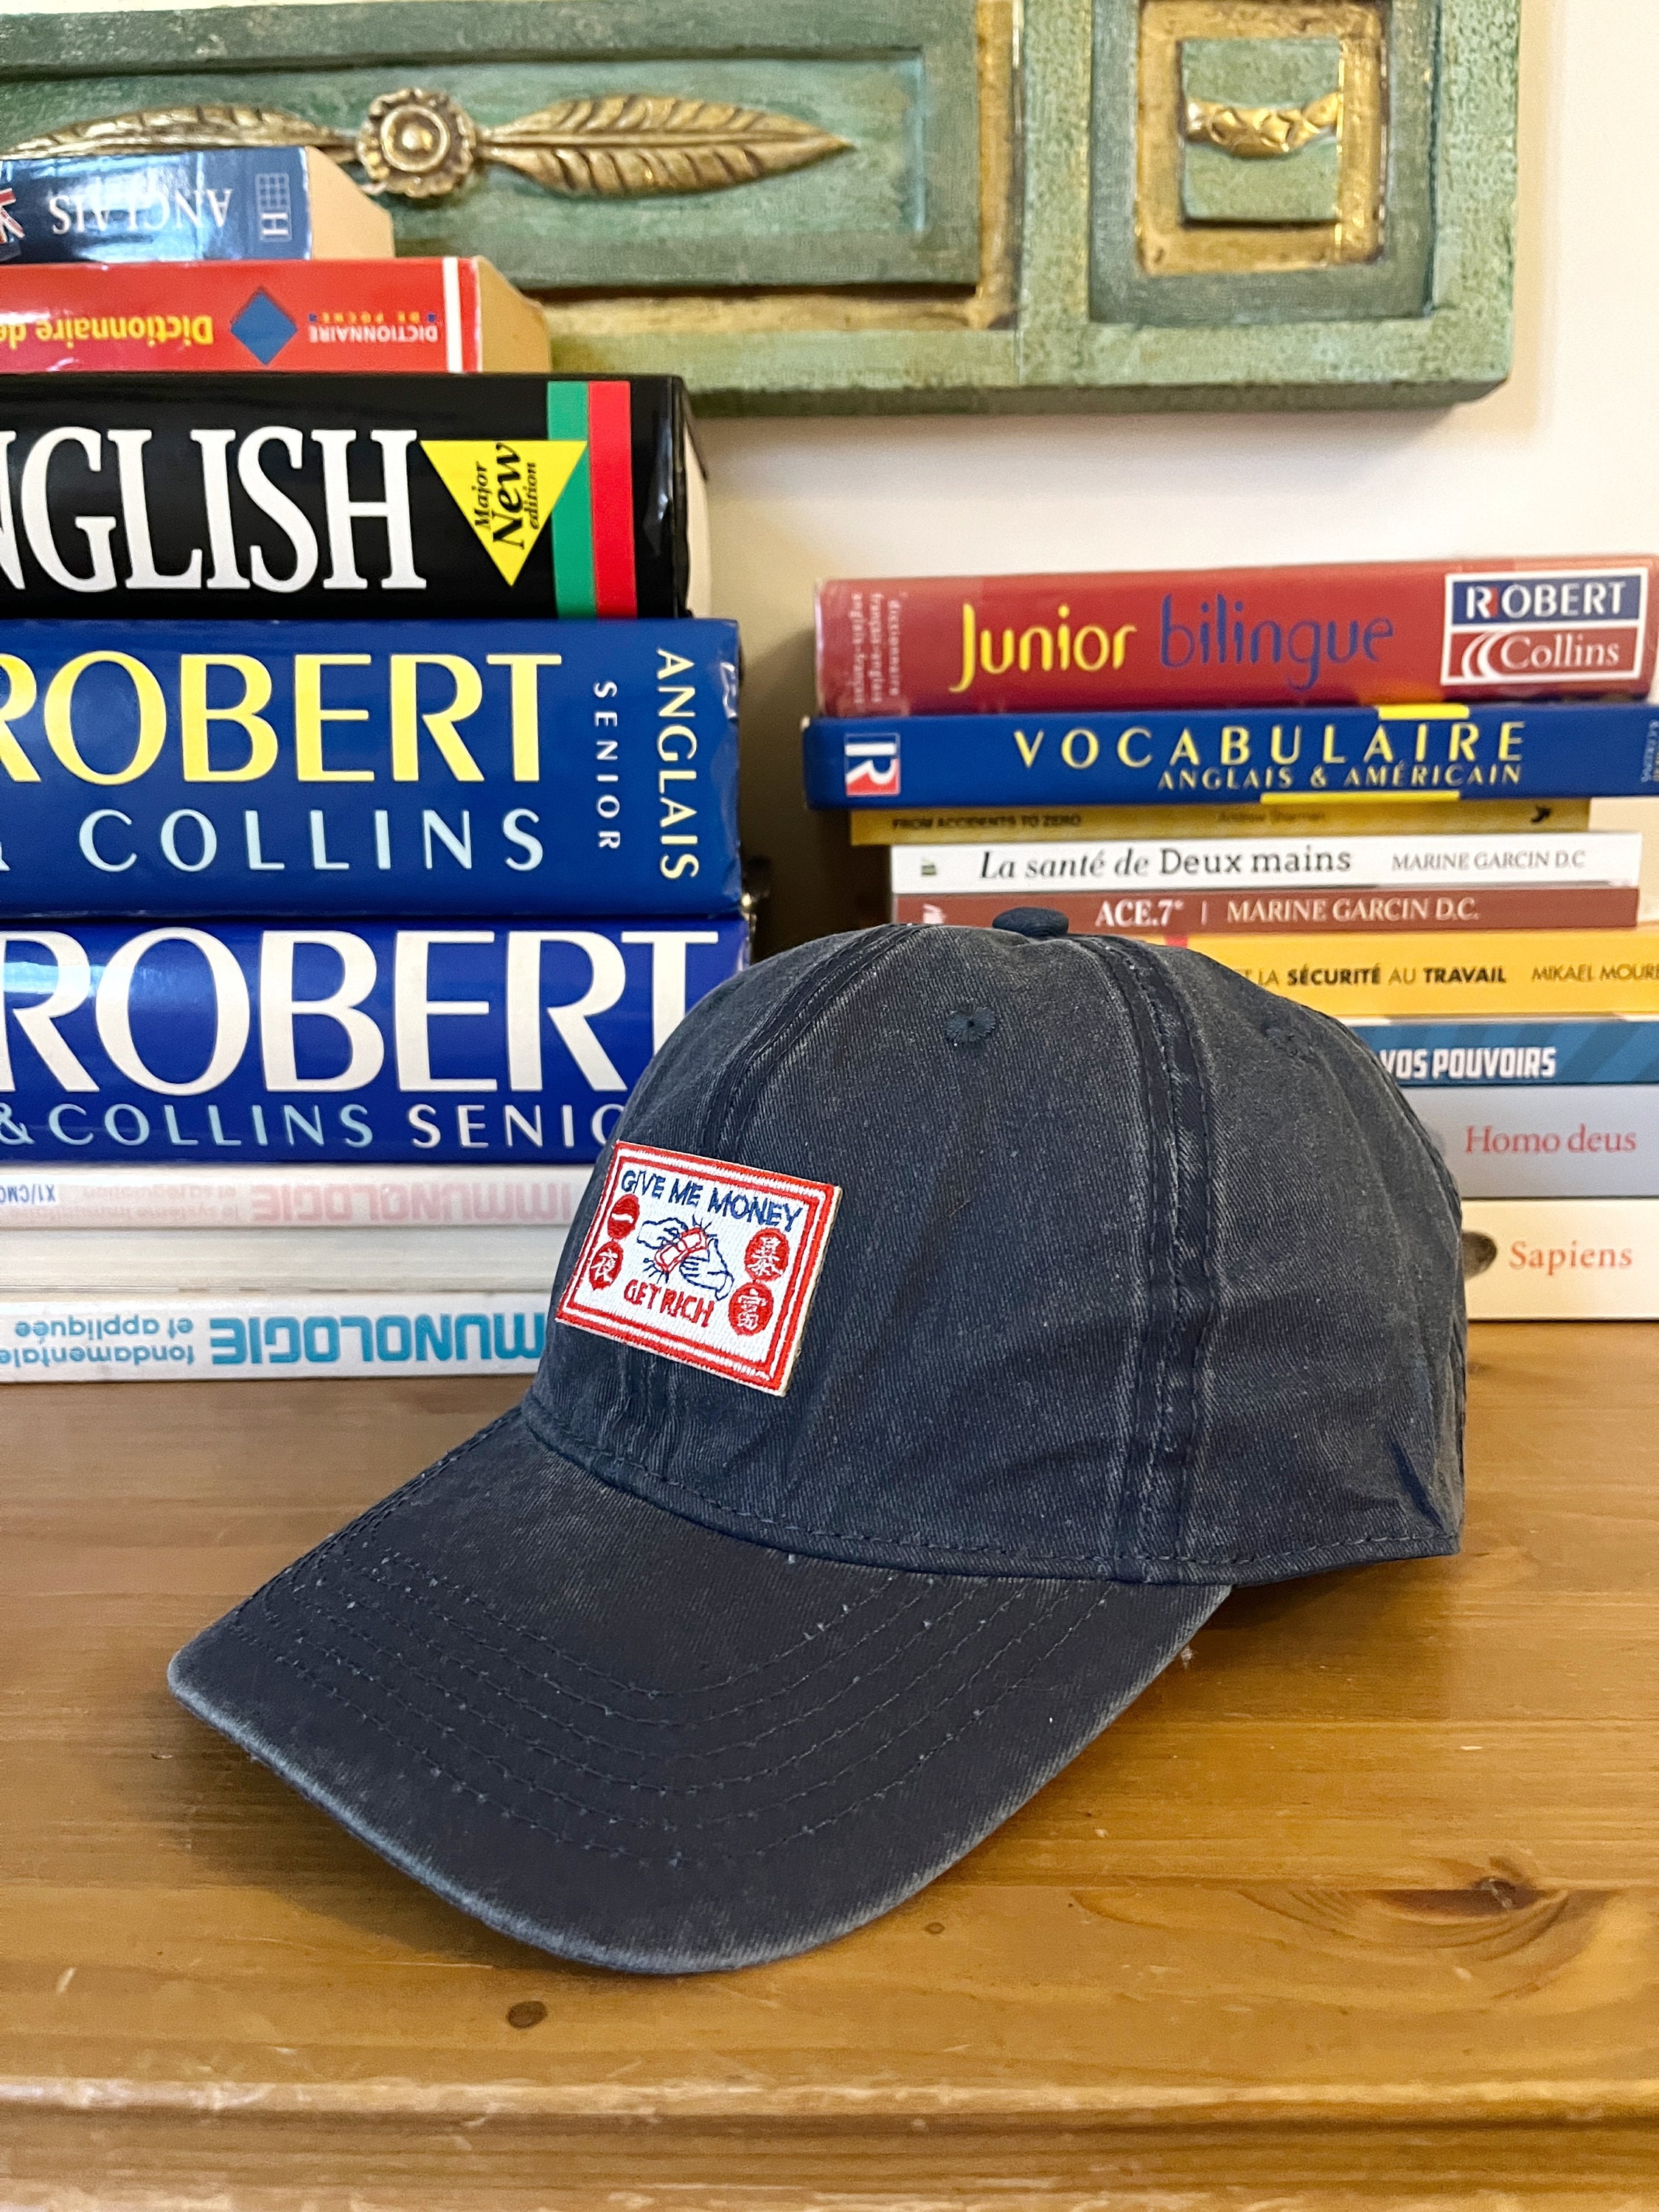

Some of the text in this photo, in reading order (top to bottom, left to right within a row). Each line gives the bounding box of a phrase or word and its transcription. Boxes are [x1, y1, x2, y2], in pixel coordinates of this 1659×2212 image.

[36, 315, 214, 348] Dictionnaire
[309, 324, 439, 343] DICTIONNAIRE
[471, 461, 493, 530] Major
[492, 442, 525, 549] New
[523, 462, 540, 530] edition
[1465, 580, 1627, 619] ROBERT
[948, 593, 1394, 693] Junior bilingue
[1500, 632, 1620, 670] Collins
[655, 648, 700, 880] ANGLAIS
[1013, 720, 1526, 769] VOCABULAIRE
[593, 681, 622, 851] SENIOR
[1158, 759, 1522, 791] ANGLAIS & AMÉRICAIN
[78, 808, 544, 873] COLLINS
[980, 846, 1352, 879] La santé de Deux mains
[1392, 852, 1470, 871] MARINE
[1474, 850, 1550, 870] GARCIN
[1227, 897, 1480, 923] MARINE GARCIN D.C.
[1287, 963, 1382, 987] SÉCURITÉ
[1388, 967, 1416, 984] AU
[1423, 966, 1507, 984] TRAVAIL
[0, 926, 719, 1096] ROBERT
[1378, 1046, 1557, 1080] VOS POUVOIRS
[0, 1102, 35, 1146] &
[47, 1103, 375, 1148] COLLINS
[1465, 1123, 1638, 1155] Homo deus
[253, 1183, 572, 1222] IMMUNOLOGIE
[621, 1169, 802, 1233] GIVE ME MONEY
[1509, 1240, 1633, 1276] Sapiens
[624, 1279, 714, 1328] GET RICH
[15, 1314, 194, 1345] et appliquée
[0, 1344, 194, 1370] fondamentale
